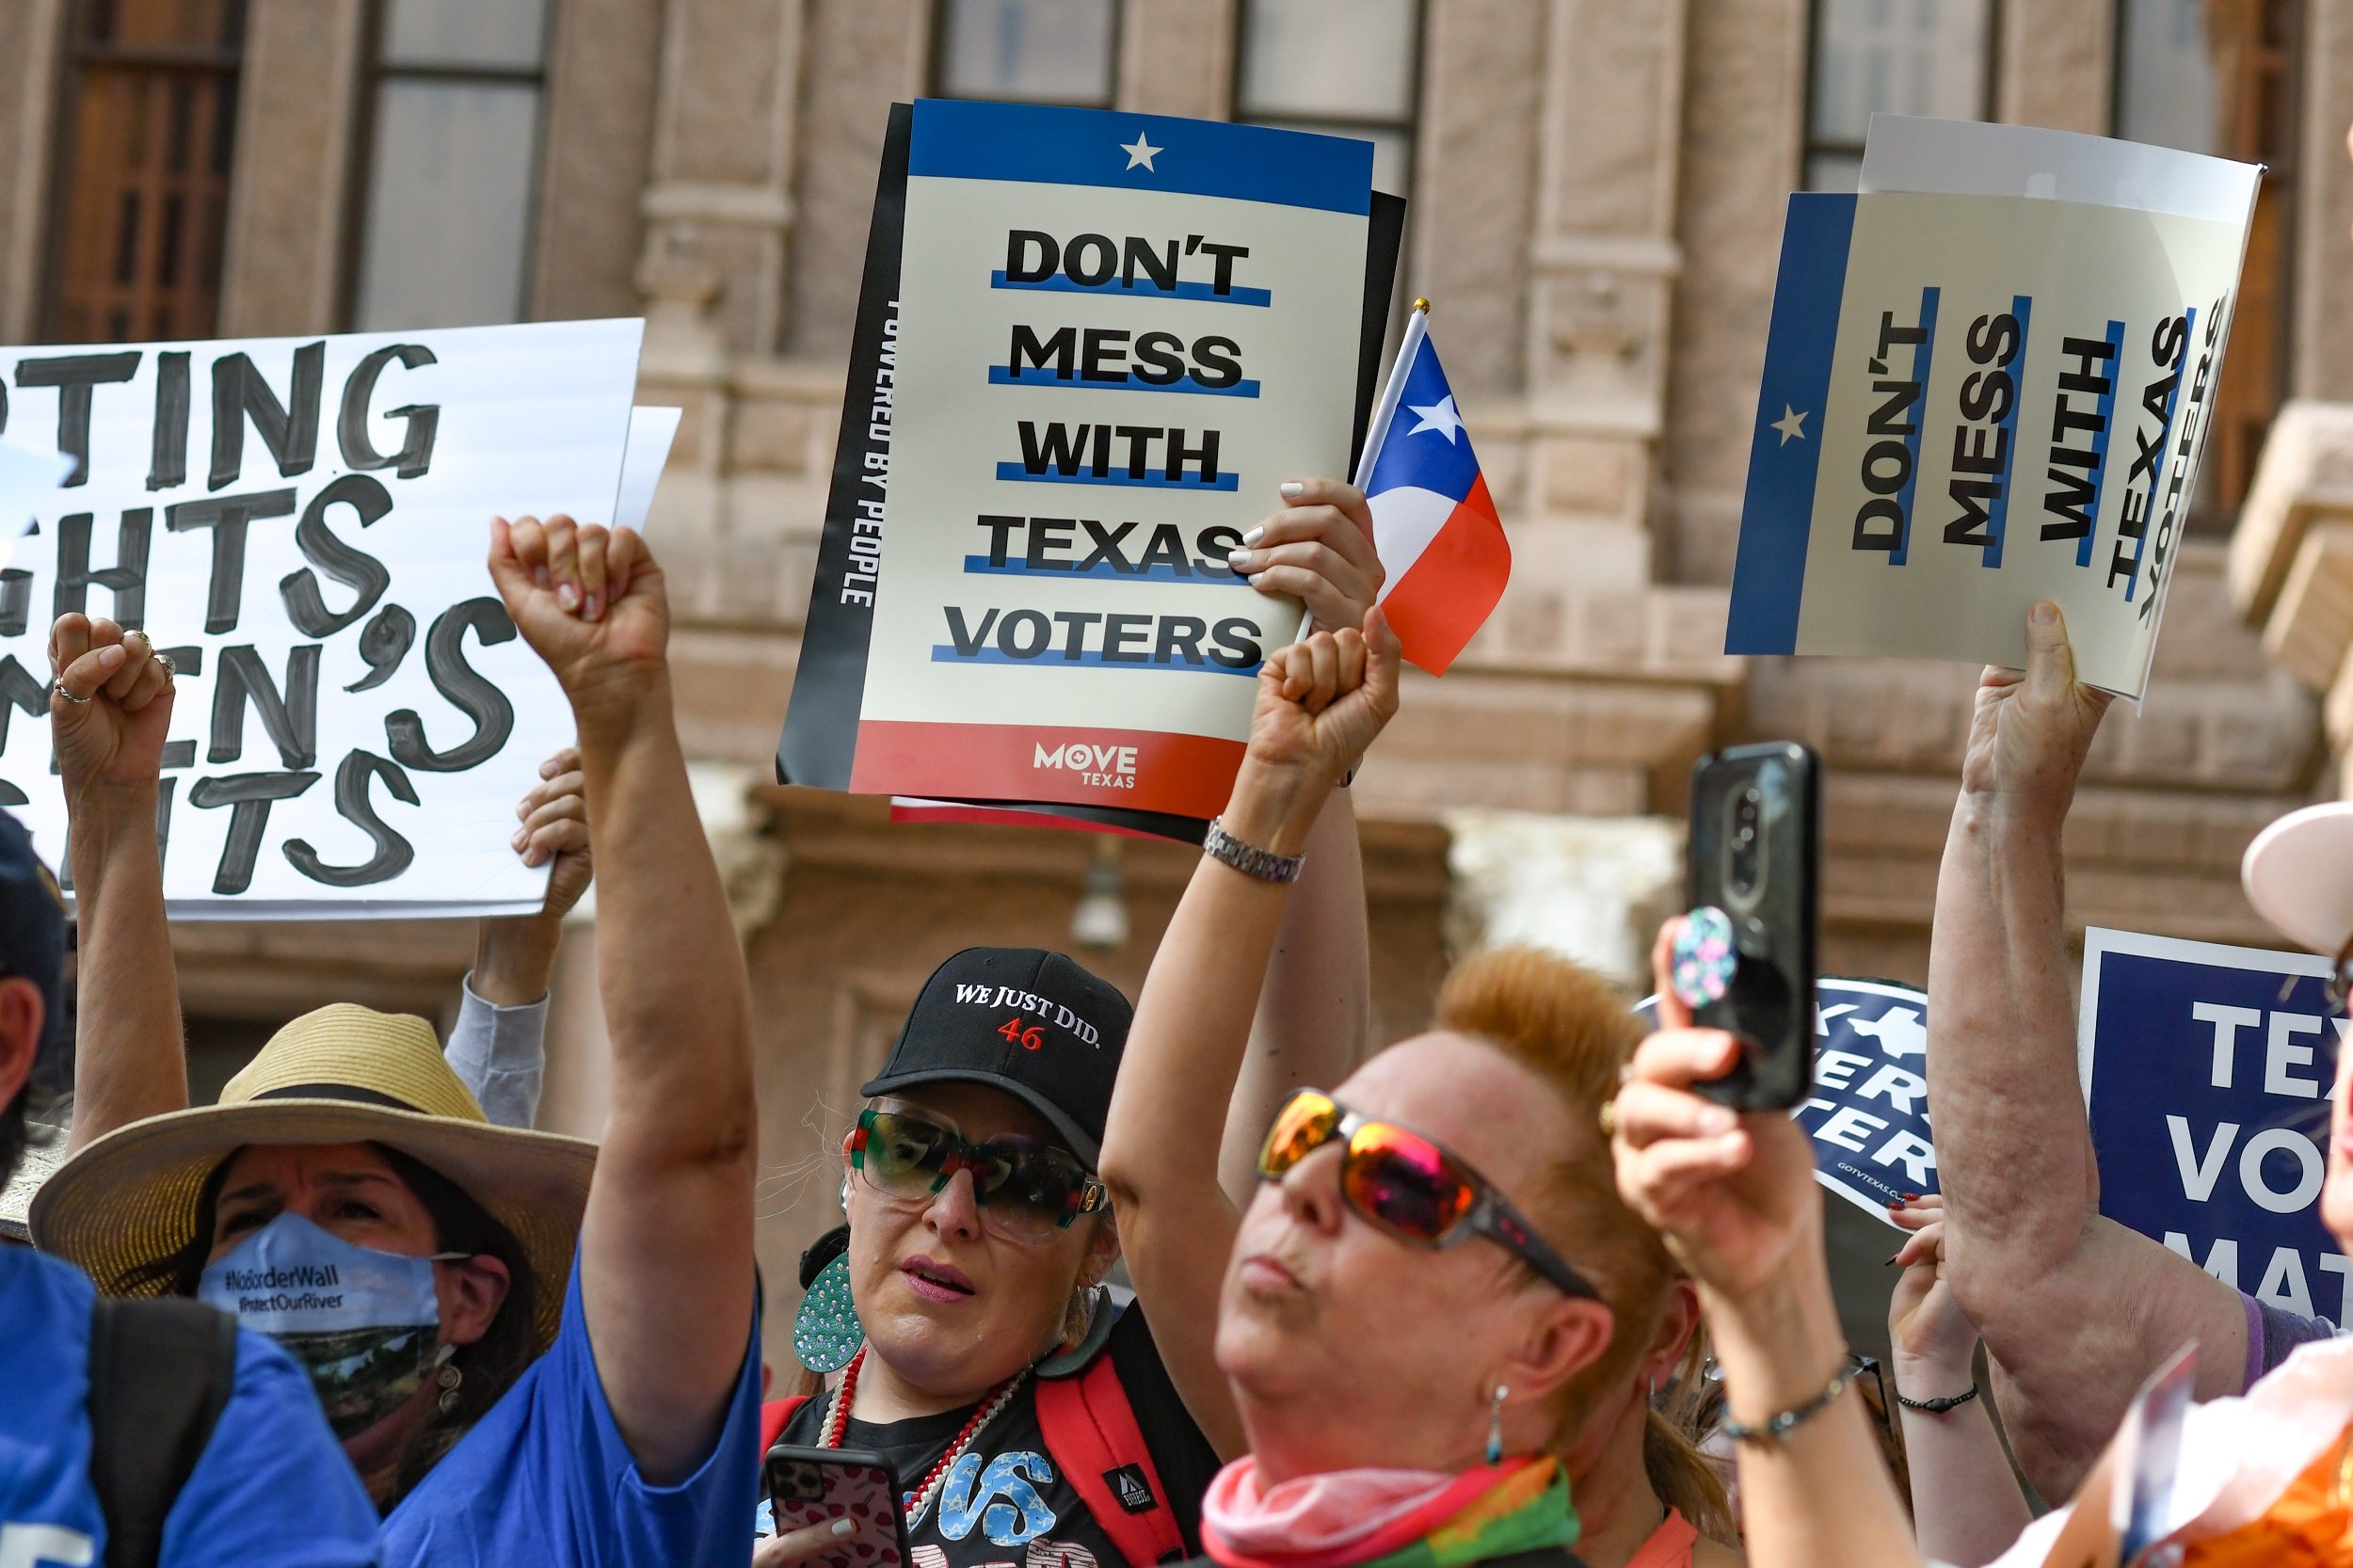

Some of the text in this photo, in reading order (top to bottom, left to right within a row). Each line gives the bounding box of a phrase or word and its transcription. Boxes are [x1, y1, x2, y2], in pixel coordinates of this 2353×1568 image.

[1005, 229, 1250, 296] DON'T
[1009, 324, 1243, 389] MESS
[0, 340, 440, 491] TING
[1851, 310, 1929, 552] DON'T
[1943, 312, 2023, 547] MESS
[2040, 336, 2117, 542] WITH
[840, 300, 900, 608] OWERED BY PEOPLE
[1016, 420, 1221, 485] WITH
[2106, 315, 2189, 589] TEXAS
[2138, 295, 2227, 622] VOTERS
[976, 514, 1245, 579] TEXAS
[943, 605, 1262, 669] VOTERS
[1032, 741, 1139, 775] MOVE
[1081, 772, 1135, 789] TEXAS
[955, 984, 1101, 1050] WE JUST DID.
[998, 1016, 1046, 1051] 46
